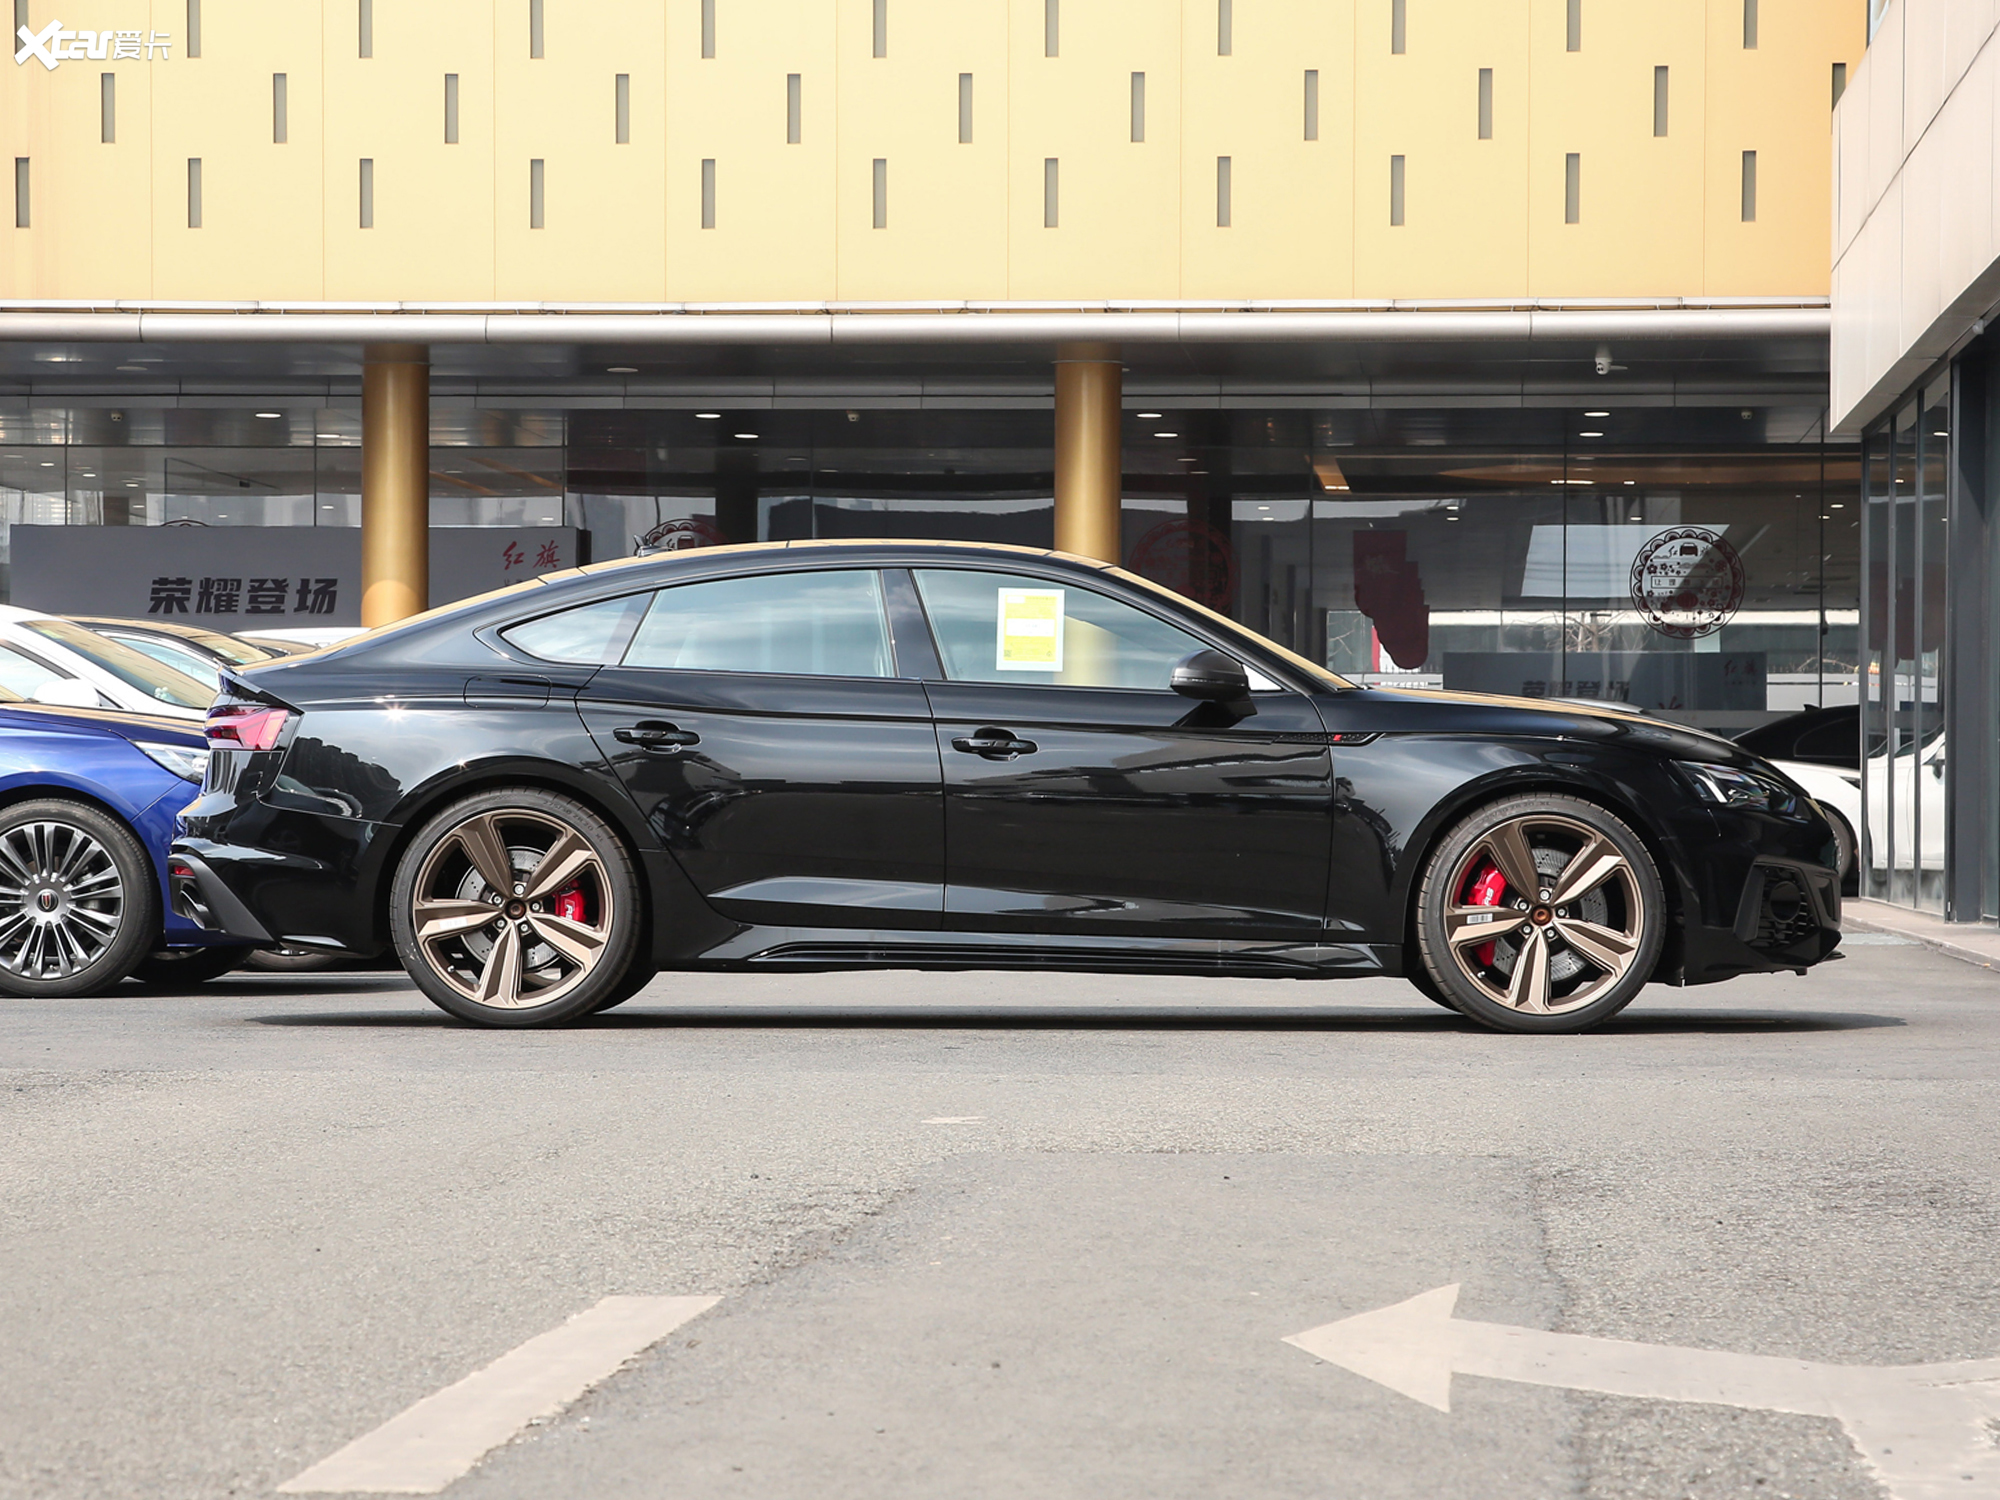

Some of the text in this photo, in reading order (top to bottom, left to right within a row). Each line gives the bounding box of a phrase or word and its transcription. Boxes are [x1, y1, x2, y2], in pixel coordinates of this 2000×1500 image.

[503, 540, 561, 571] 红旗
[148, 577, 338, 614] 荣耀登场
